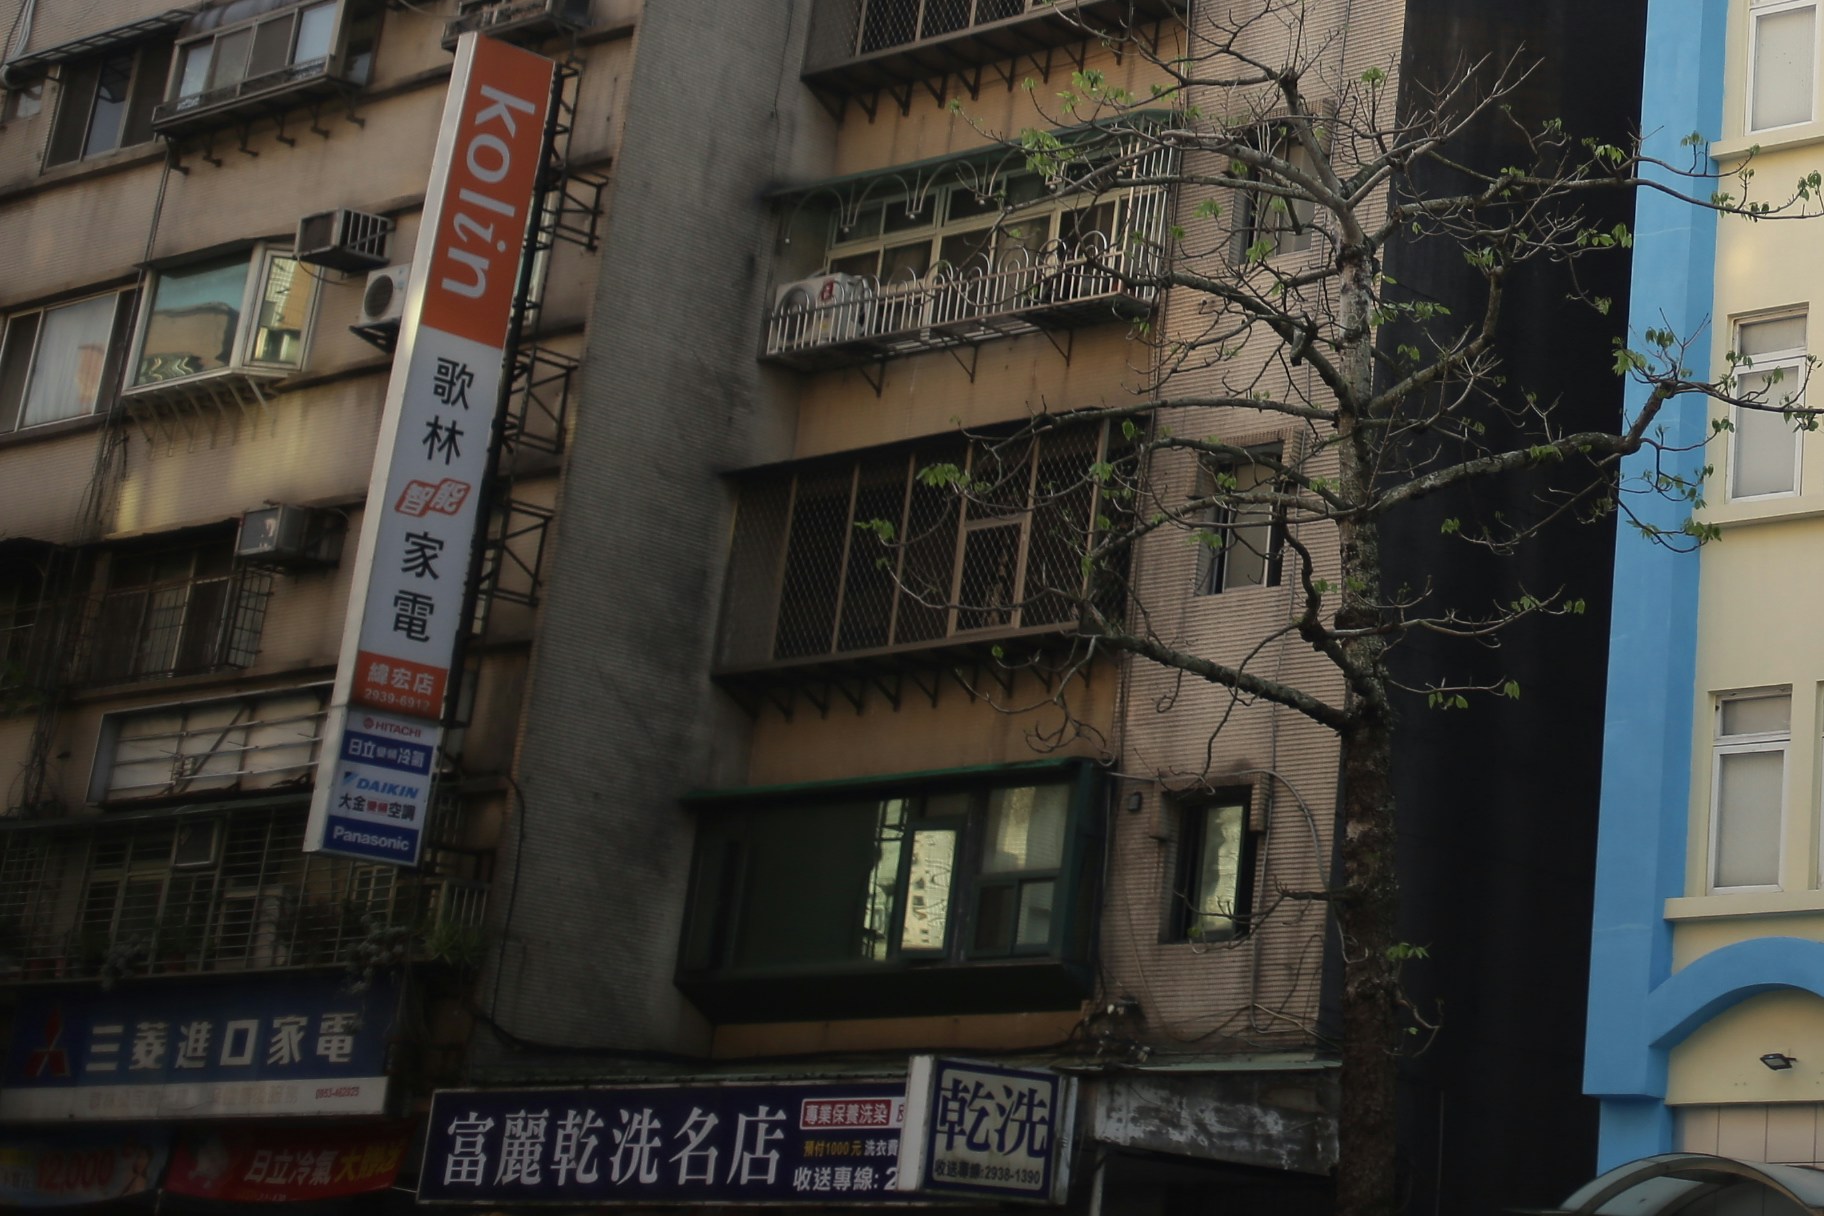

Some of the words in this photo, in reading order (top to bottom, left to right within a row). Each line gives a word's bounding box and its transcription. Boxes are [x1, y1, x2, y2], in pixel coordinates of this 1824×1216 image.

[374, 720, 422, 738] HITACHI
[356, 777, 420, 799] DAIKIN
[332, 824, 410, 852] Panasonic
[85, 1011, 359, 1073] 三菱進口家電
[804, 1103, 889, 1125] 專業保養洗染
[936, 1078, 1049, 1158] 乾洗
[441, 1102, 788, 1188] 富麗乾洗名店
